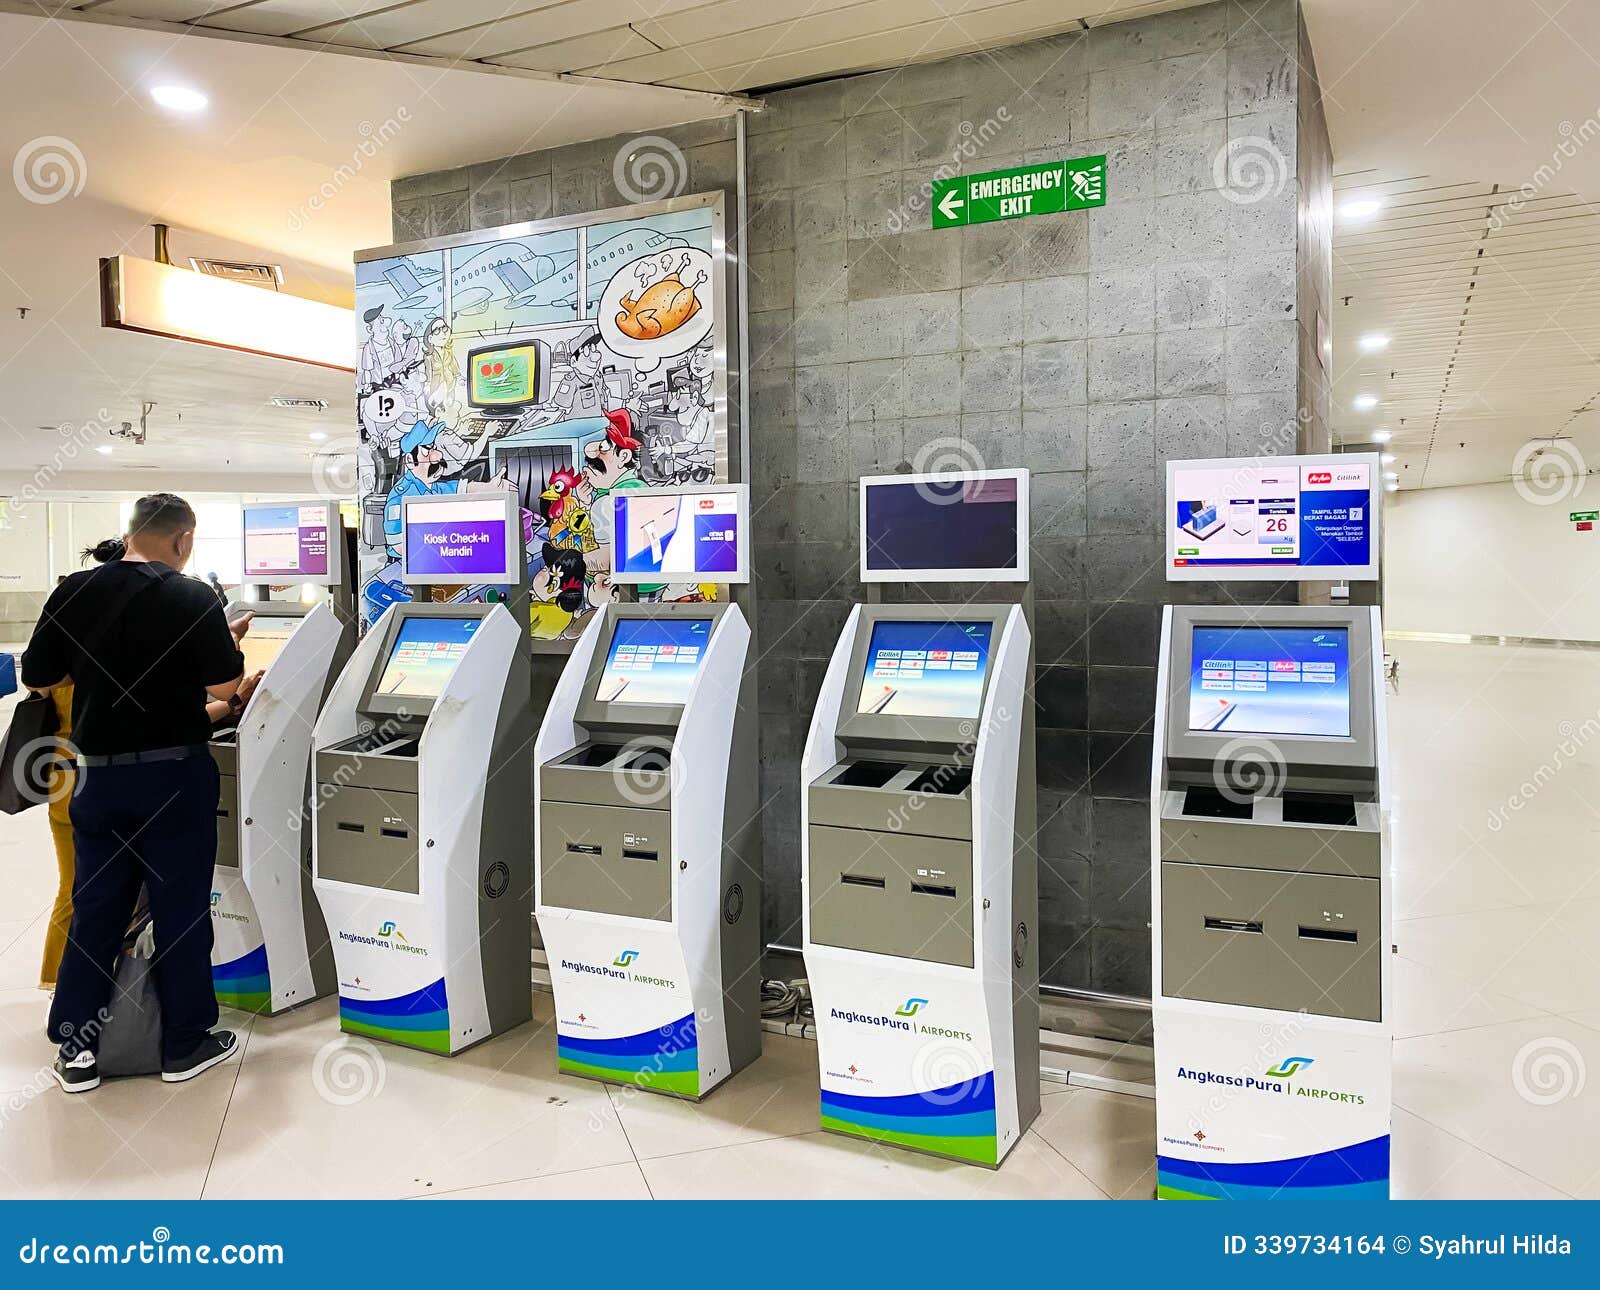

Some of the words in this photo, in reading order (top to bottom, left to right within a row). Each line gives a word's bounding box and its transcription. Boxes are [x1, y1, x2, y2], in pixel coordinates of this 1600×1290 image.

[970, 168, 1063, 200] EMERGENCY
[1000, 195, 1033, 217] EXIT
[574, 513, 586, 530] 1
[1266, 518, 1287, 532] 26
[423, 533, 448, 545] Kiosk
[449, 531, 490, 544] Check-in
[440, 545, 473, 557] Mandiri
[395, 943, 428, 956] AIRPORTS
[633, 974, 676, 989] AIRPORTS
[920, 1024, 973, 1042] AIRPORTS
[1296, 1086, 1365, 1105] AIRPORTS
